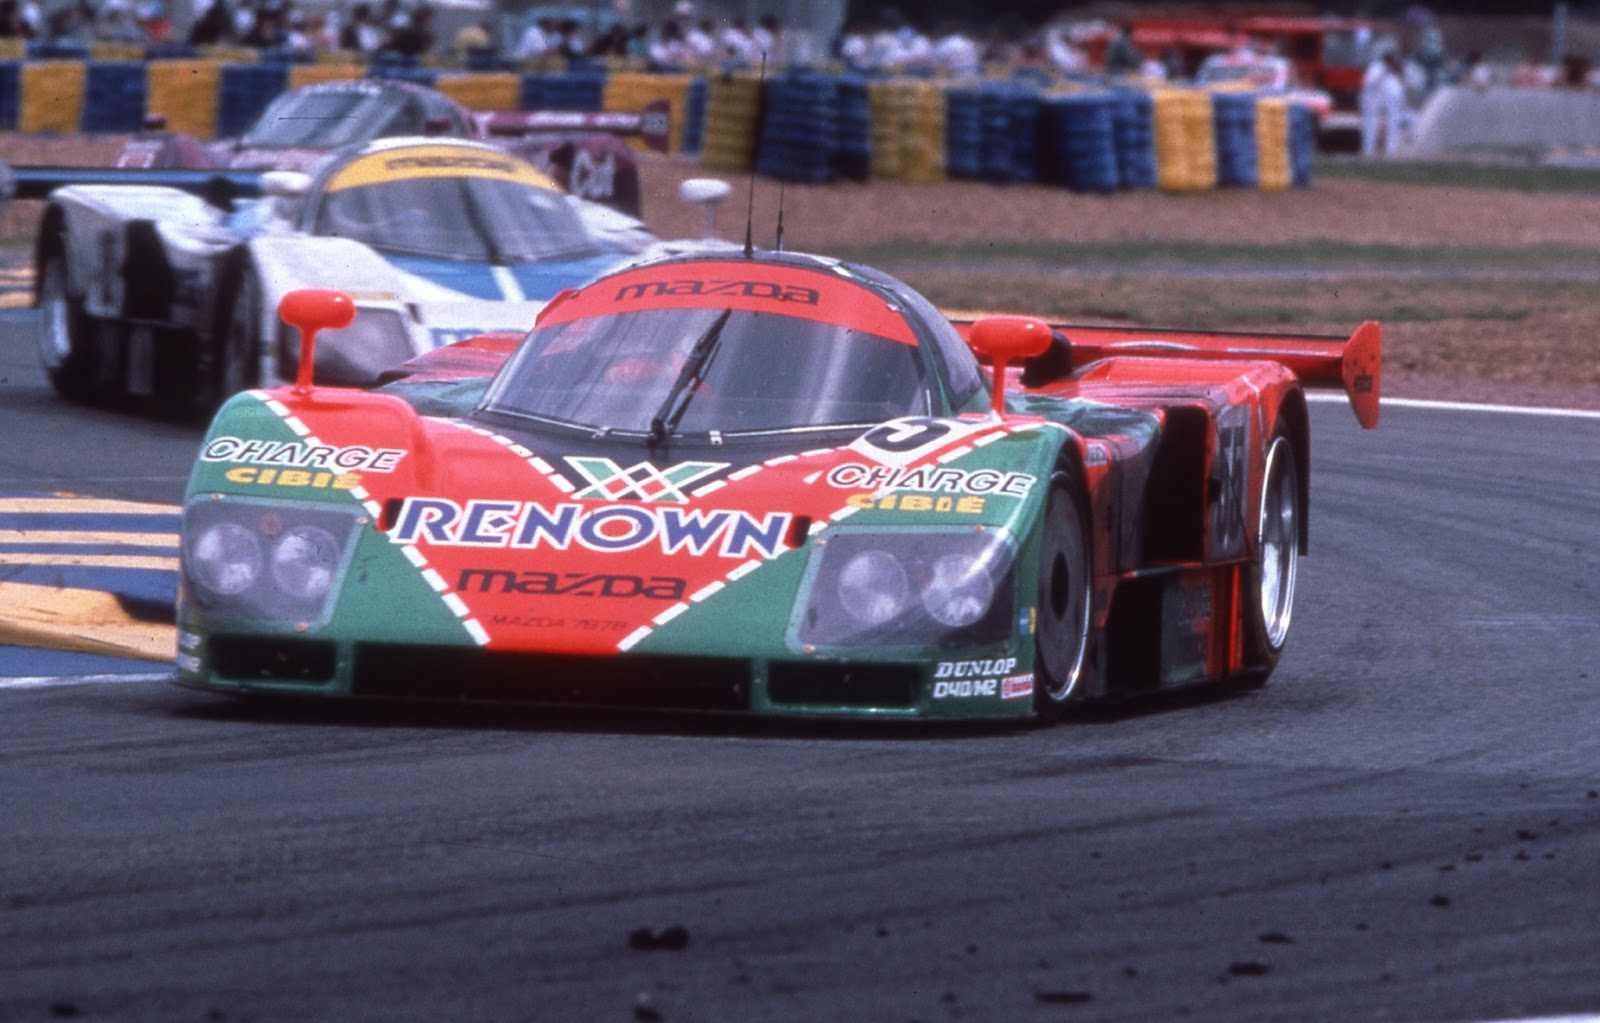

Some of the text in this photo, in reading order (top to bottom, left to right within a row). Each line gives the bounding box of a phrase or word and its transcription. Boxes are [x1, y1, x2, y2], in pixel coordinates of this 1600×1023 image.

[201, 436, 408, 473] CHARGE
[826, 463, 1038, 500] CHARGE
[389, 497, 793, 559] RENOWN
[456, 569, 688, 600] mazda
[934, 657, 1017, 678] DUNLOP
